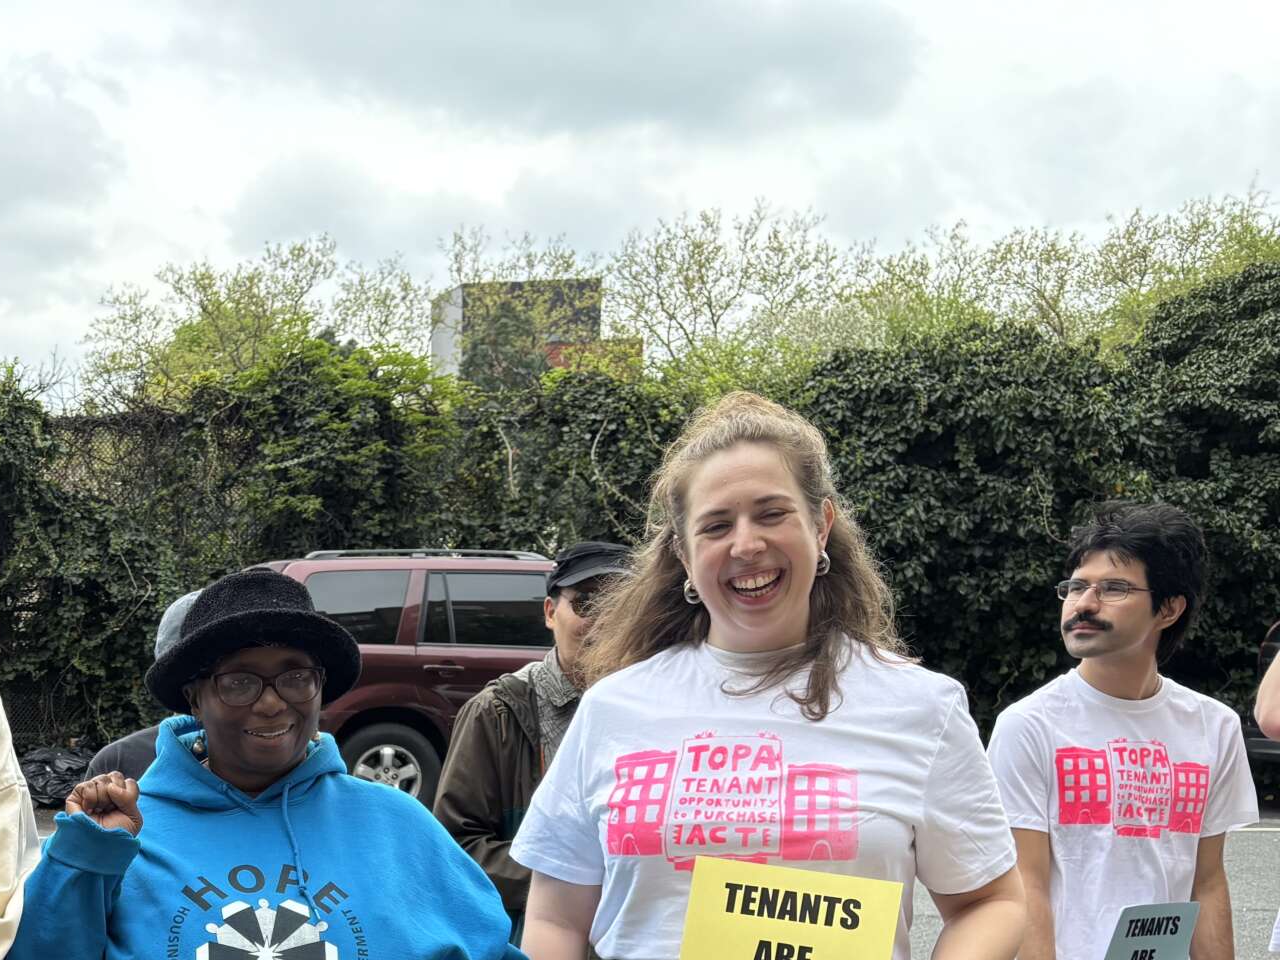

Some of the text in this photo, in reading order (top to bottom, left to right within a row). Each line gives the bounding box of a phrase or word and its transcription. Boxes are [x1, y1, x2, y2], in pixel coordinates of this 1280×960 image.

[688, 744, 779, 772] TOPA
[1113, 747, 1167, 768] TOPA
[682, 777, 778, 794] TENANT
[1117, 770, 1168, 784] TENANT
[679, 796, 778, 808] OPPORTUNITY
[674, 810, 777, 823] to PURCHASE
[181, 864, 349, 914] HOPE
[725, 882, 862, 930] TENANTS
[1125, 916, 1180, 938] TENANTS
